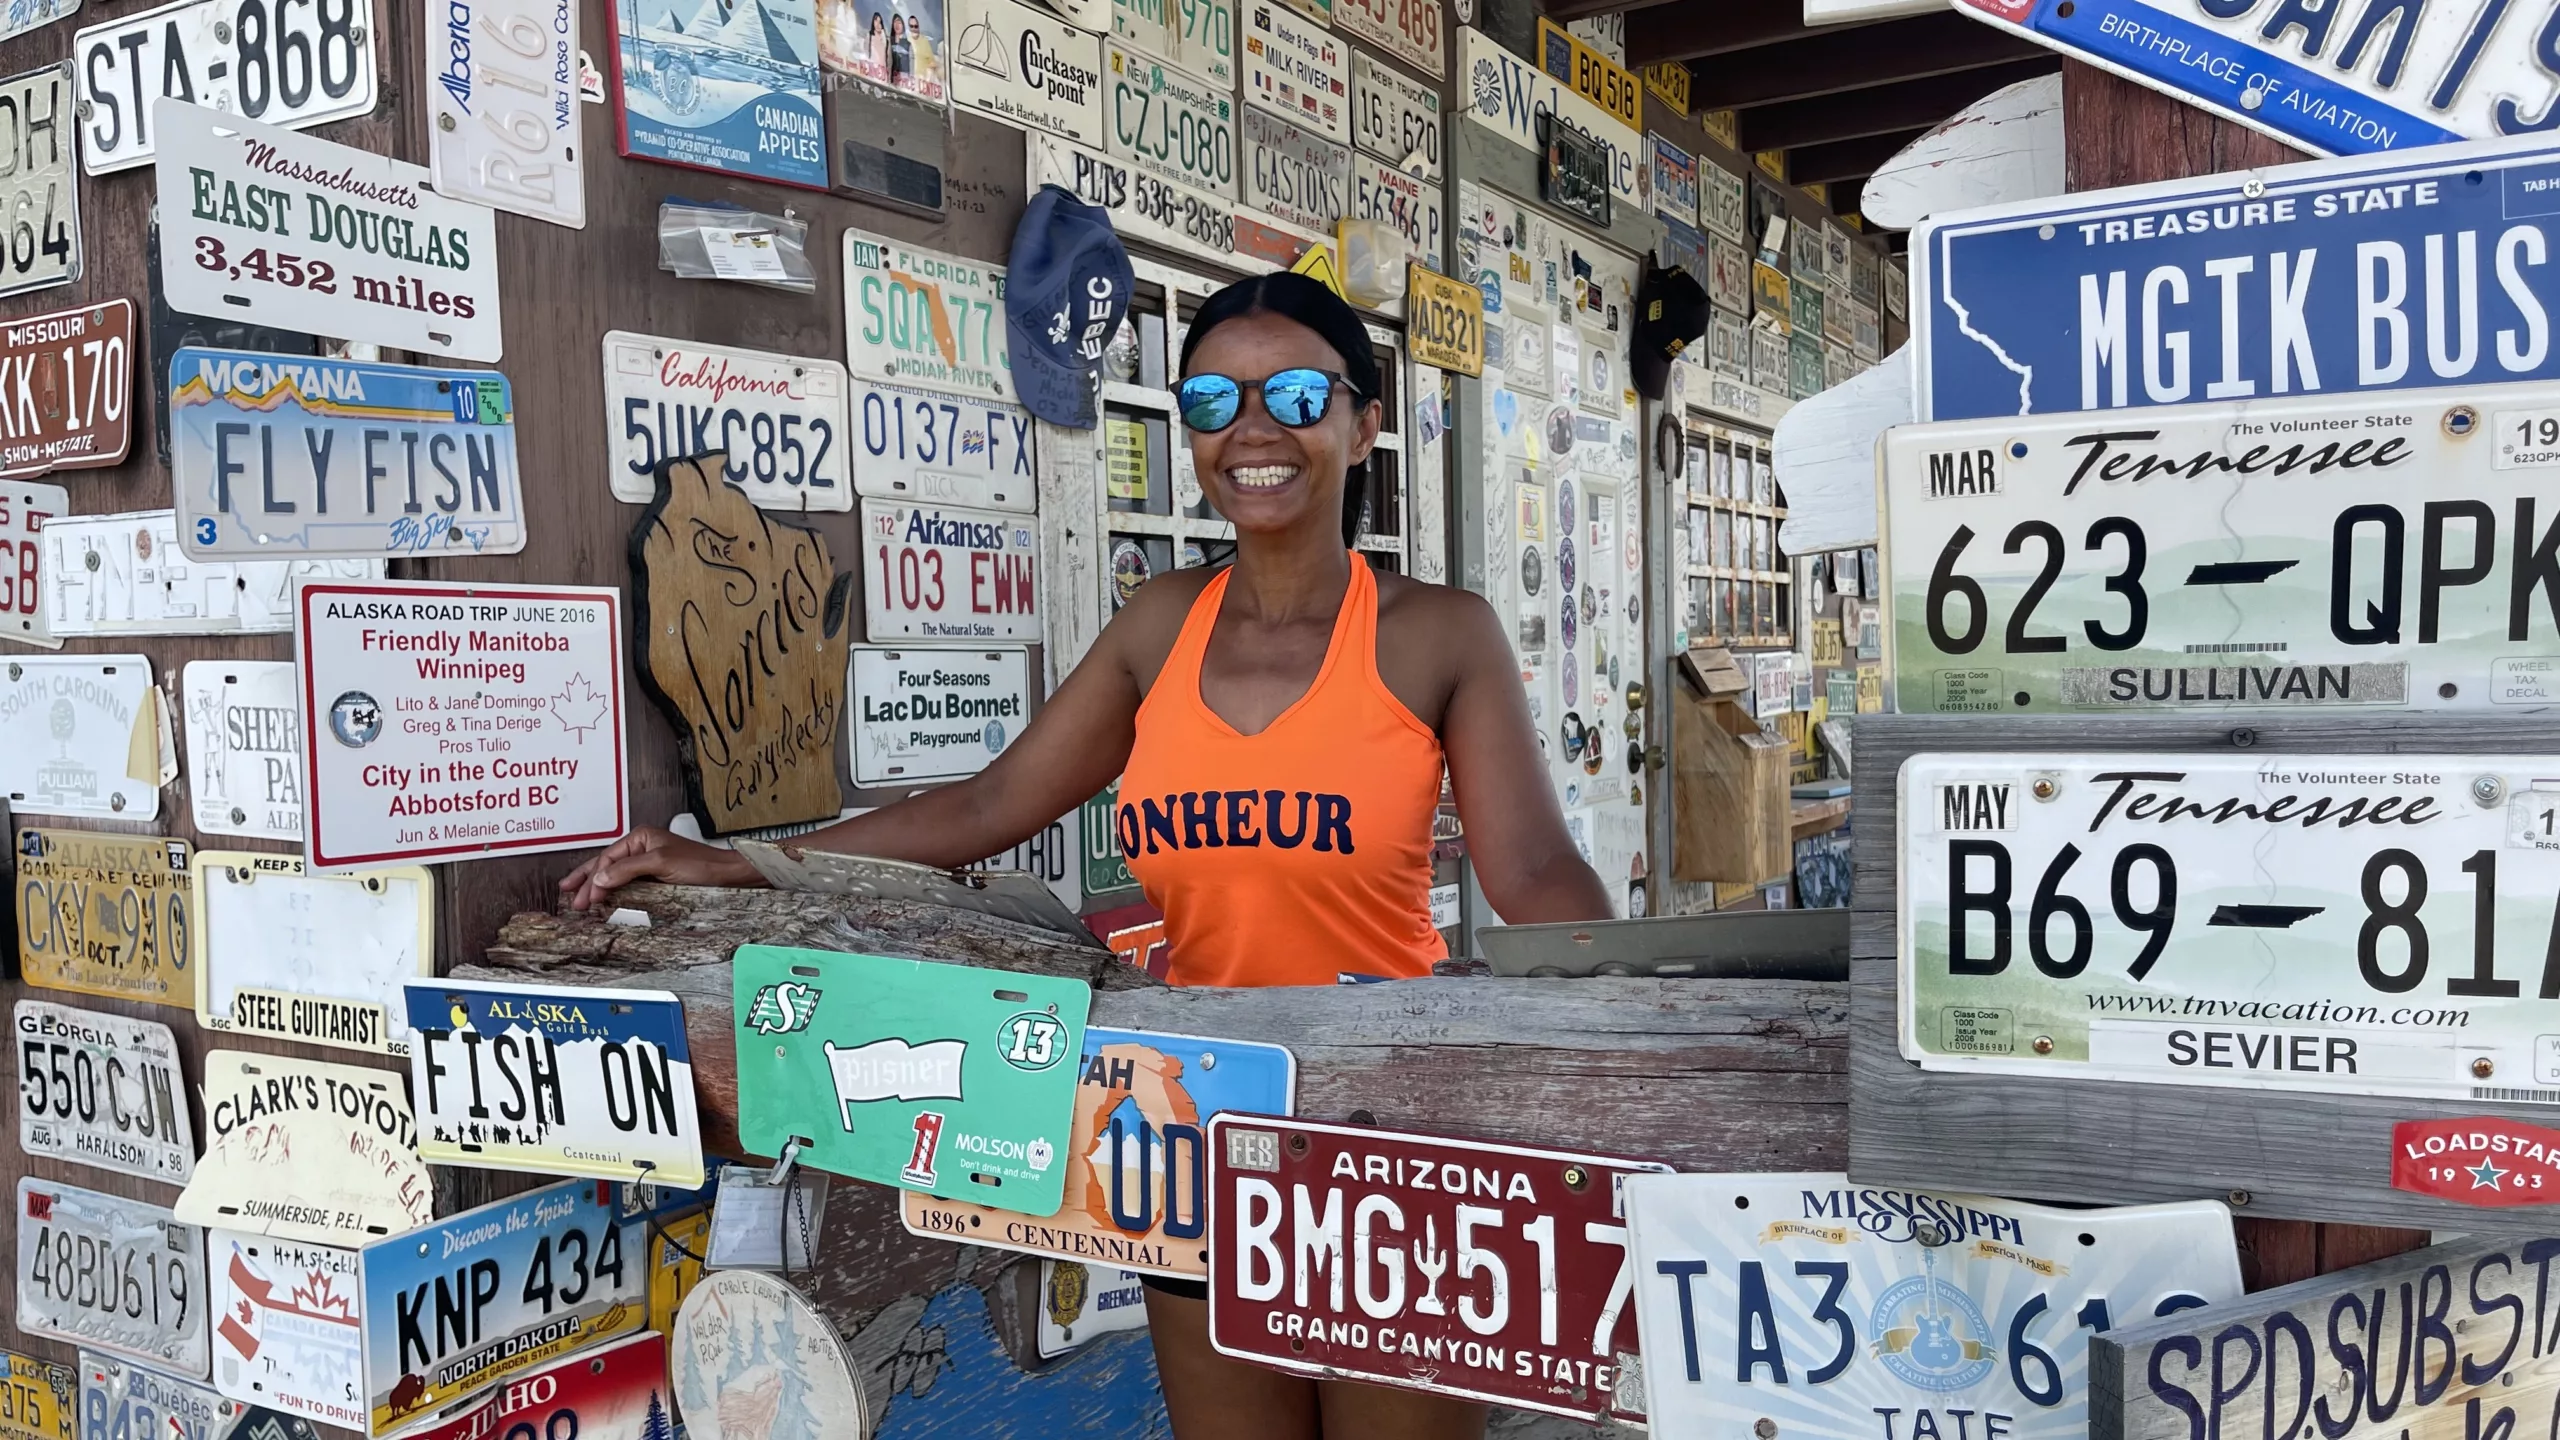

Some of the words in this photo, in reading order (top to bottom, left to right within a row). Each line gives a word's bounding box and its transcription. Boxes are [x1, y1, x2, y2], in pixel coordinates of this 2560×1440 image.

[438, 1, 471, 116] Alberta
[1019, 28, 1098, 90] Chickasaw
[1266, 44, 1294, 77] MILK
[1296, 60, 1330, 94] RIVER
[1046, 77, 1086, 107] point
[1127, 64, 1150, 87] NEW
[1163, 80, 1218, 117] HAMPSHIRE
[1369, 62, 1394, 90] NEBR
[1397, 81, 1424, 107] TRUCK
[1579, 50, 1603, 108] BQ
[1606, 68, 1635, 121] 518
[2099, 12, 2245, 84] BIRTHPLACE
[2246, 70, 2281, 98] OF
[2281, 87, 2398, 149] AVIATION
[754, 104, 819, 139] CANADIAN
[994, 95, 1015, 116] Lake
[1015, 103, 1051, 130] Hartwell,
[1115, 80, 1232, 185] CZJ-080
[758, 131, 820, 163] APPLES
[244, 138, 420, 210] Massachusetts
[1144, 160, 1161, 174] LIVE
[1163, 166, 1181, 180] FREE
[1182, 173, 1193, 184] OR
[1194, 178, 1207, 189] DIE
[1255, 145, 1343, 222] GASTONS
[1378, 168, 1420, 199] MAINE
[188, 166, 292, 237] EAST
[310, 193, 471, 272] DOUGLAS
[2079, 199, 2298, 246] TREASURE
[2312, 180, 2440, 217] STATE
[855, 243, 879, 269] JAN
[899, 252, 982, 288] FLORIDA
[195, 236, 337, 296] 3,452
[354, 273, 475, 319] miles
[8, 316, 85, 348] MISSOURI
[2080, 247, 2322, 410] MGIK
[2356, 224, 2550, 387] BUS
[200, 357, 365, 401] MONTANA
[660, 350, 806, 404] California
[895, 357, 947, 381] INDIAN
[951, 368, 994, 390] RIVER
[863, 391, 960, 468] 0137
[986, 411, 1031, 477] FX
[2231, 422, 2264, 436] The
[2269, 417, 2360, 434] Volunteer
[2365, 413, 2413, 429] State
[216, 422, 333, 514] FLY
[1930, 451, 1995, 497] MAR
[2063, 430, 2416, 497] Tennessee
[197, 518, 217, 545] 3
[904, 509, 1005, 551] Arkansas
[879, 544, 946, 612] 103
[970, 551, 1035, 616] EWW
[1925, 515, 2148, 655] 623
[326, 602, 408, 623] ALASKA
[411, 604, 468, 623] ROAD
[470, 605, 508, 623] TRIP
[512, 605, 556, 624] JUNE
[559, 606, 596, 624] 2016
[921, 621, 938, 636] The
[938, 622, 972, 637] Natural
[973, 623, 996, 637] State
[361, 629, 461, 657] Friendly
[469, 629, 570, 654] Manitoba
[416, 656, 526, 685] Winnipeg
[898, 669, 931, 688] Four
[932, 669, 991, 688] Seasons
[2108, 664, 2352, 702] SULLIVAN
[395, 695, 424, 711] Lito
[428, 695, 440, 711] &
[444, 695, 479, 711] Jane
[483, 693, 547, 715] Domingo
[864, 694, 909, 723] Lac
[910, 694, 943, 720] Du
[945, 691, 1021, 719] Bonnet
[403, 718, 441, 738] Greg
[443, 718, 456, 733] &
[461, 717, 491, 732] Tina
[495, 716, 542, 735] Derige
[438, 739, 471, 755] Pros
[475, 737, 511, 753] Tulio
[909, 728, 982, 750] Playground
[362, 762, 411, 790] City
[419, 761, 442, 784] in
[448, 758, 485, 782] the
[492, 756, 579, 786] Country
[2258, 772, 2292, 785] The
[2298, 771, 2389, 785] Volunteer
[2393, 772, 2442, 786] State
[388, 786, 521, 817] Abbotsford
[528, 785, 560, 806] BC
[1943, 784, 2010, 832] MAY
[2088, 771, 2443, 834] Tennessee
[396, 827, 424, 845] Jun
[426, 827, 439, 842] &
[444, 822, 499, 840] Melanie
[504, 816, 555, 835] Castillo
[254, 858, 289, 873] KEEP
[1947, 838, 2178, 984] B69
[2355, 847, 2560, 1000] 81
[238, 992, 286, 1033] STEEL
[291, 999, 379, 1046] GUITARIST
[488, 1001, 587, 1025] ALASKA
[547, 1022, 575, 1034] Gold
[581, 1024, 609, 1037] Rush
[2085, 992, 2471, 1028] www.tnvacation.com
[19, 1015, 118, 1048] GEORGIA
[1009, 1018, 1059, 1062] 13
[2166, 1028, 2359, 1076] SEVIER
[24, 1041, 96, 1124] 550
[107, 1056, 179, 1145] CJW
[423, 1028, 566, 1126] FISH
[600, 1041, 679, 1137] ON
[214, 1074, 318, 1136] CLARK'S
[76, 1132, 146, 1167] HARALSON
[563, 1146, 622, 1163] Centennial
[955, 1132, 1025, 1160] MOLSON
[960, 1157, 980, 1171] Don't
[982, 1163, 1002, 1175] drink
[1003, 1167, 1019, 1177] and
[1021, 1169, 1041, 1181] drive
[1332, 1151, 1537, 1203] ARIZONA
[442, 1221, 502, 1260] Discover
[505, 1208, 529, 1234] the
[534, 1197, 574, 1228] Spirit
[920, 1207, 966, 1234] 1896
[1774, 1223, 1829, 1240] BIRTHPLACE
[1831, 1231, 1844, 1242] OF
[1799, 1189, 2026, 1248] MISSISSIPPI
[1006, 1222, 1172, 1267] CENTENNIAL
[1979, 1243, 2023, 1264] America's
[2025, 1257, 2052, 1274] Music
[1235, 1176, 1405, 1321] BMG
[1455, 1202, 1637, 1357] 517
[397, 1256, 499, 1378] KNP
[522, 1226, 624, 1315] 434
[439, 1344, 501, 1389] NORTH
[504, 1316, 581, 1356] DAKOTA
[460, 1373, 486, 1392] PEACE
[489, 1355, 528, 1378] GARDEN
[530, 1342, 561, 1364] STATE
[1267, 1311, 1369, 1350] GRAND
[1377, 1328, 1505, 1372] CANYON
[1515, 1350, 1612, 1393] STATE
[147, 1382, 211, 1422] Québec
